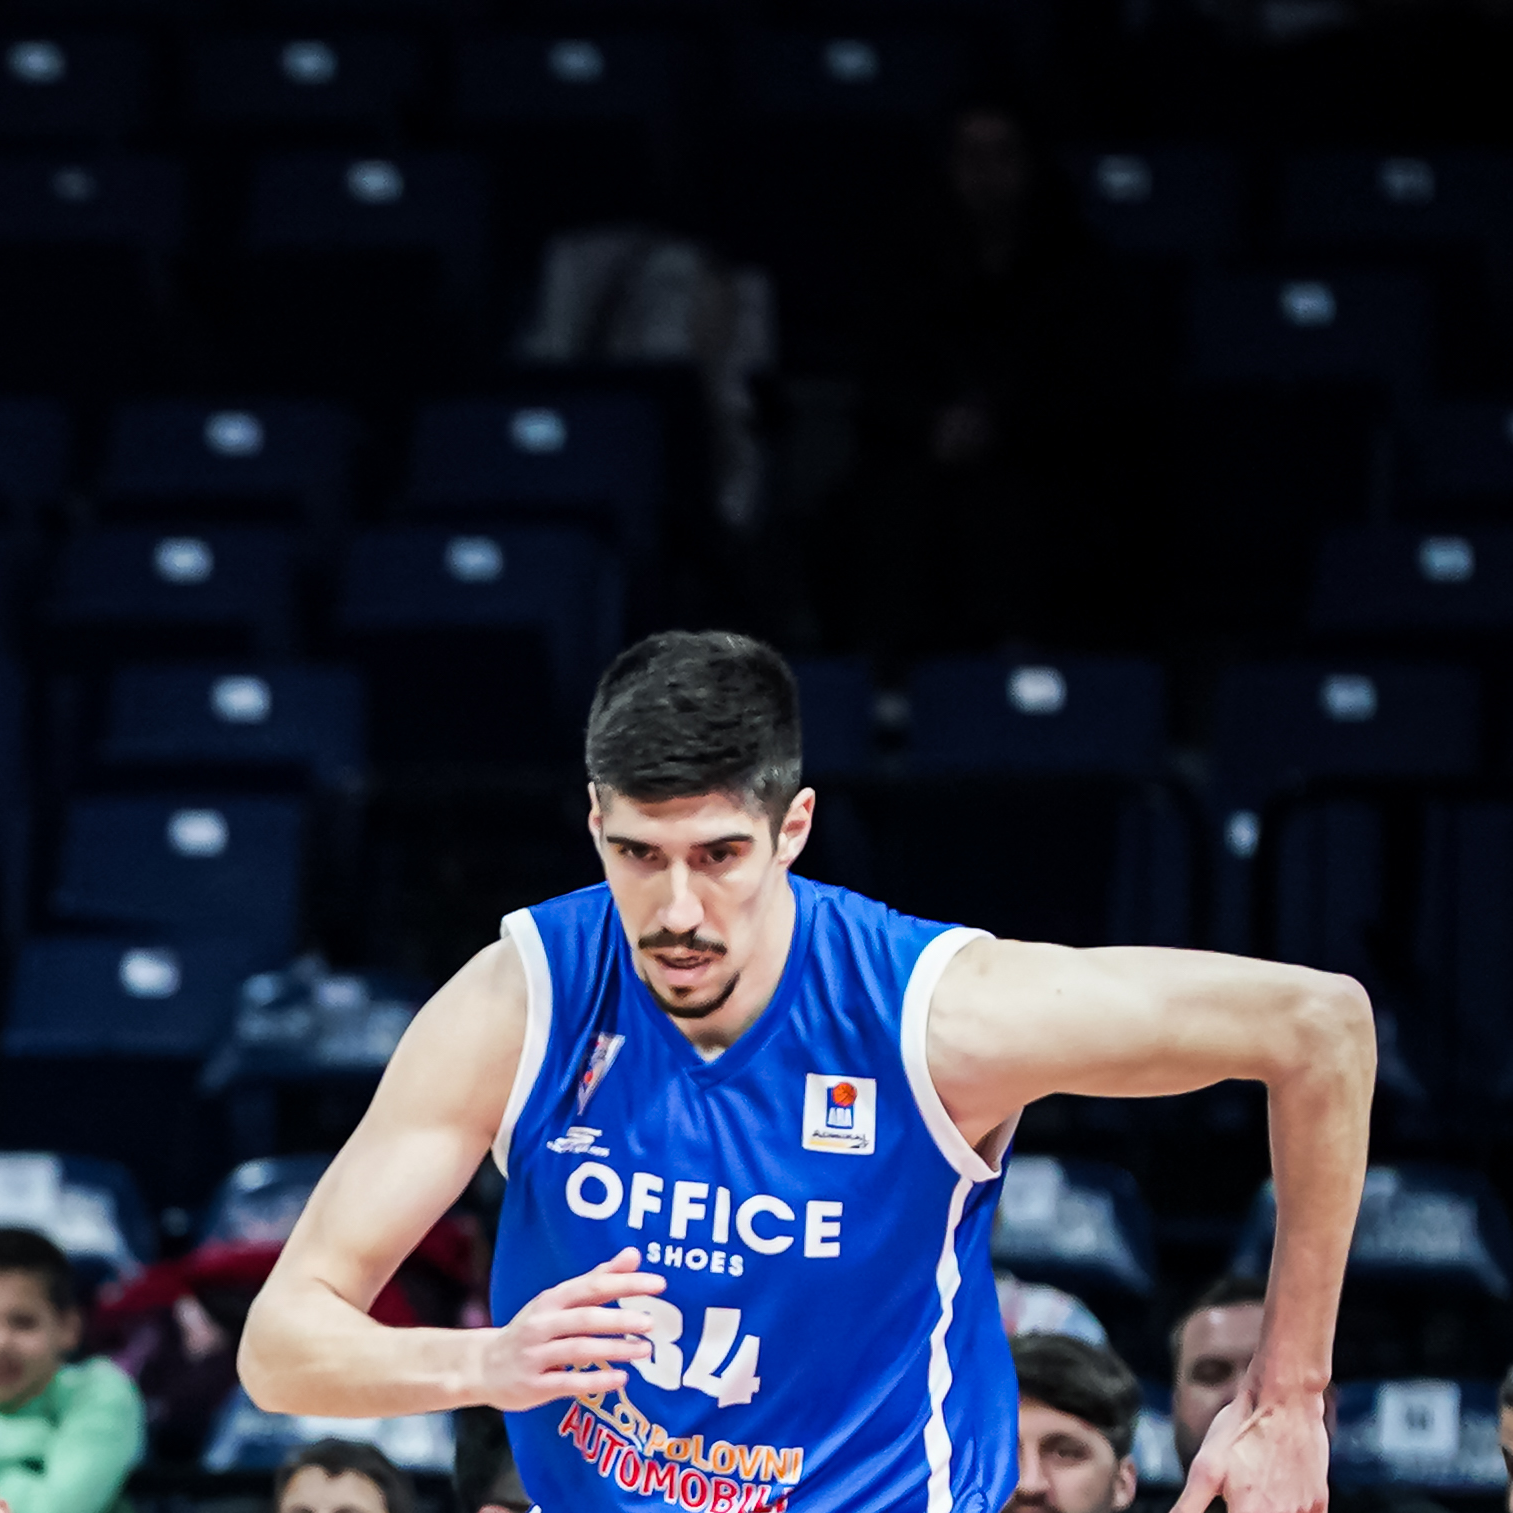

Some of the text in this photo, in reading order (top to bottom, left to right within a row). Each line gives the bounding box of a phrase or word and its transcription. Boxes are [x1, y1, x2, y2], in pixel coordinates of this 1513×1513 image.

[565, 1161, 844, 1258] OFFICE
[647, 1241, 745, 1278] SHOES
[644, 1424, 805, 1485] POLOVNI
